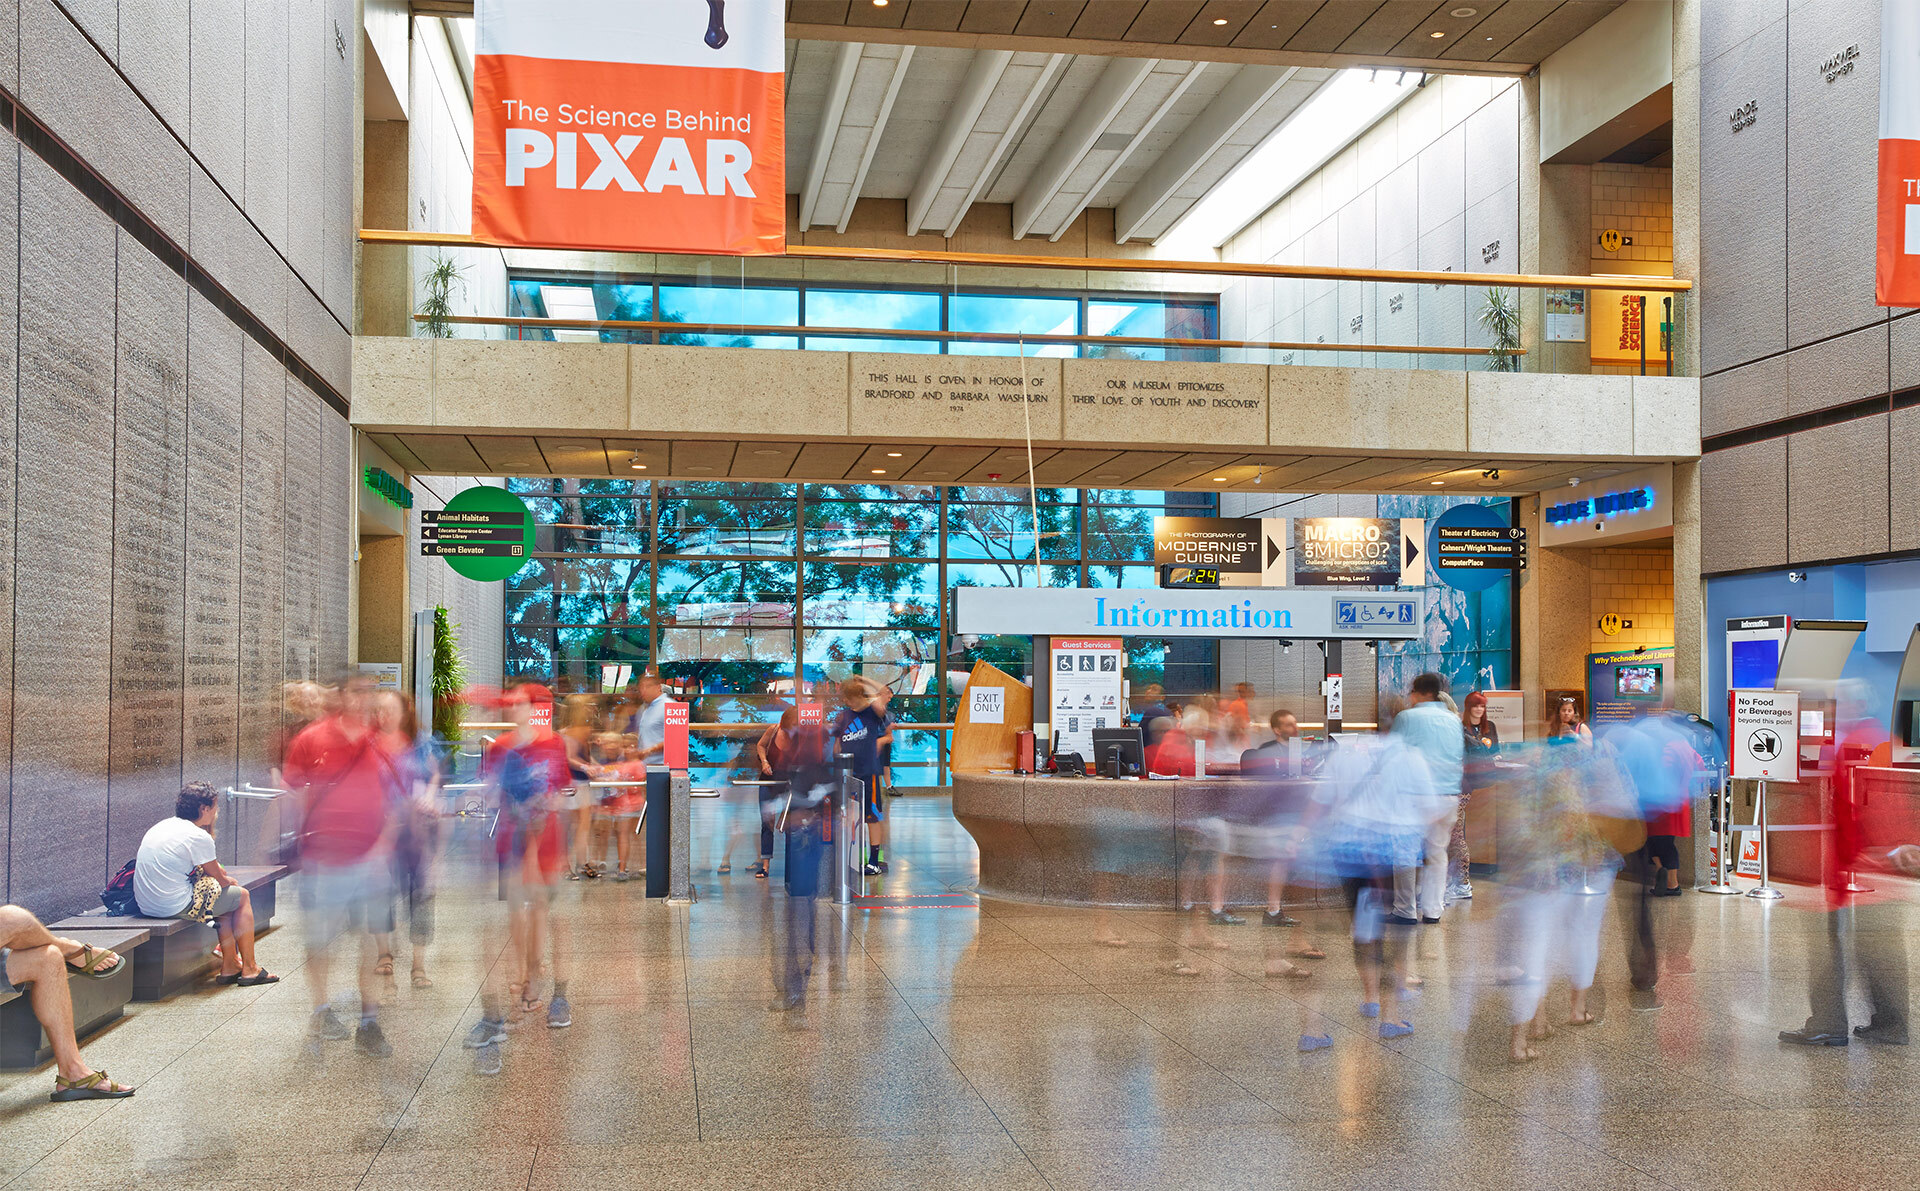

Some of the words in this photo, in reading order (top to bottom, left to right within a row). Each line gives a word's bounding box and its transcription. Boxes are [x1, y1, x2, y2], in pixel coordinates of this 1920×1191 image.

[502, 99, 549, 123] The
[557, 103, 657, 129] Science
[665, 109, 751, 134] Behind
[505, 127, 757, 198] PIXAR
[1620, 294, 1629, 306] in
[1629, 295, 1640, 351] SCIENCE
[1619, 308, 1629, 351] Women
[869, 373, 889, 383] THIS
[895, 374, 917, 383] HALL
[924, 375, 932, 384] IS
[938, 375, 966, 385] GIVEN
[973, 376, 982, 385] IN
[989, 376, 1024, 386] HONOR
[1031, 377, 1044, 387] OF
[1106, 379, 1127, 389] OUR
[1132, 380, 1171, 390] MUSEUM
[1177, 381, 1225, 391] EPITOMIZES
[864, 389, 916, 400] BRADFORD
[921, 390, 943, 400] AND
[950, 391, 990, 401] BARBARA
[1072, 394, 1096, 404] THEIR
[1102, 395, 1124, 405] LOVE
[1131, 396, 1145, 406] OF
[1150, 397, 1181, 407] YOUTH
[1186, 397, 1206, 407] AND
[1212, 398, 1260, 409] DISCOVERY
[437, 513, 460, 521] Animal
[462, 514, 489, 522] Habitats
[1304, 525, 1380, 541] MACRO
[1441, 529, 1463, 537] Theater
[1463, 529, 1470, 537] of
[1471, 529, 1500, 538] Electricity
[458, 546, 485, 554] Elevator
[1158, 541, 1258, 552] MODERNIST
[1305, 543, 1314, 558] OR
[1315, 541, 1390, 558] MICRO?
[1487, 544, 1512, 552] Theaters
[1175, 553, 1241, 564] CUISINE
[1441, 559, 1484, 567] ComputerPlace
[1186, 569, 1217, 583] 1:24
[1094, 597, 1294, 629] Information
[1595, 656, 1609, 664] Why
[1610, 652, 1654, 663] Technological
[976, 693, 998, 703] EXIT
[1752, 698, 1774, 706] Food
[666, 708, 687, 716] EXIT
[973, 702, 1000, 712] ONLY
[1749, 707, 1793, 717] Beverages
[800, 709, 820, 717] EXIT
[528, 718, 550, 726] ONLY
[665, 717, 687, 725] ONLY
[800, 718, 821, 726] ONLY
